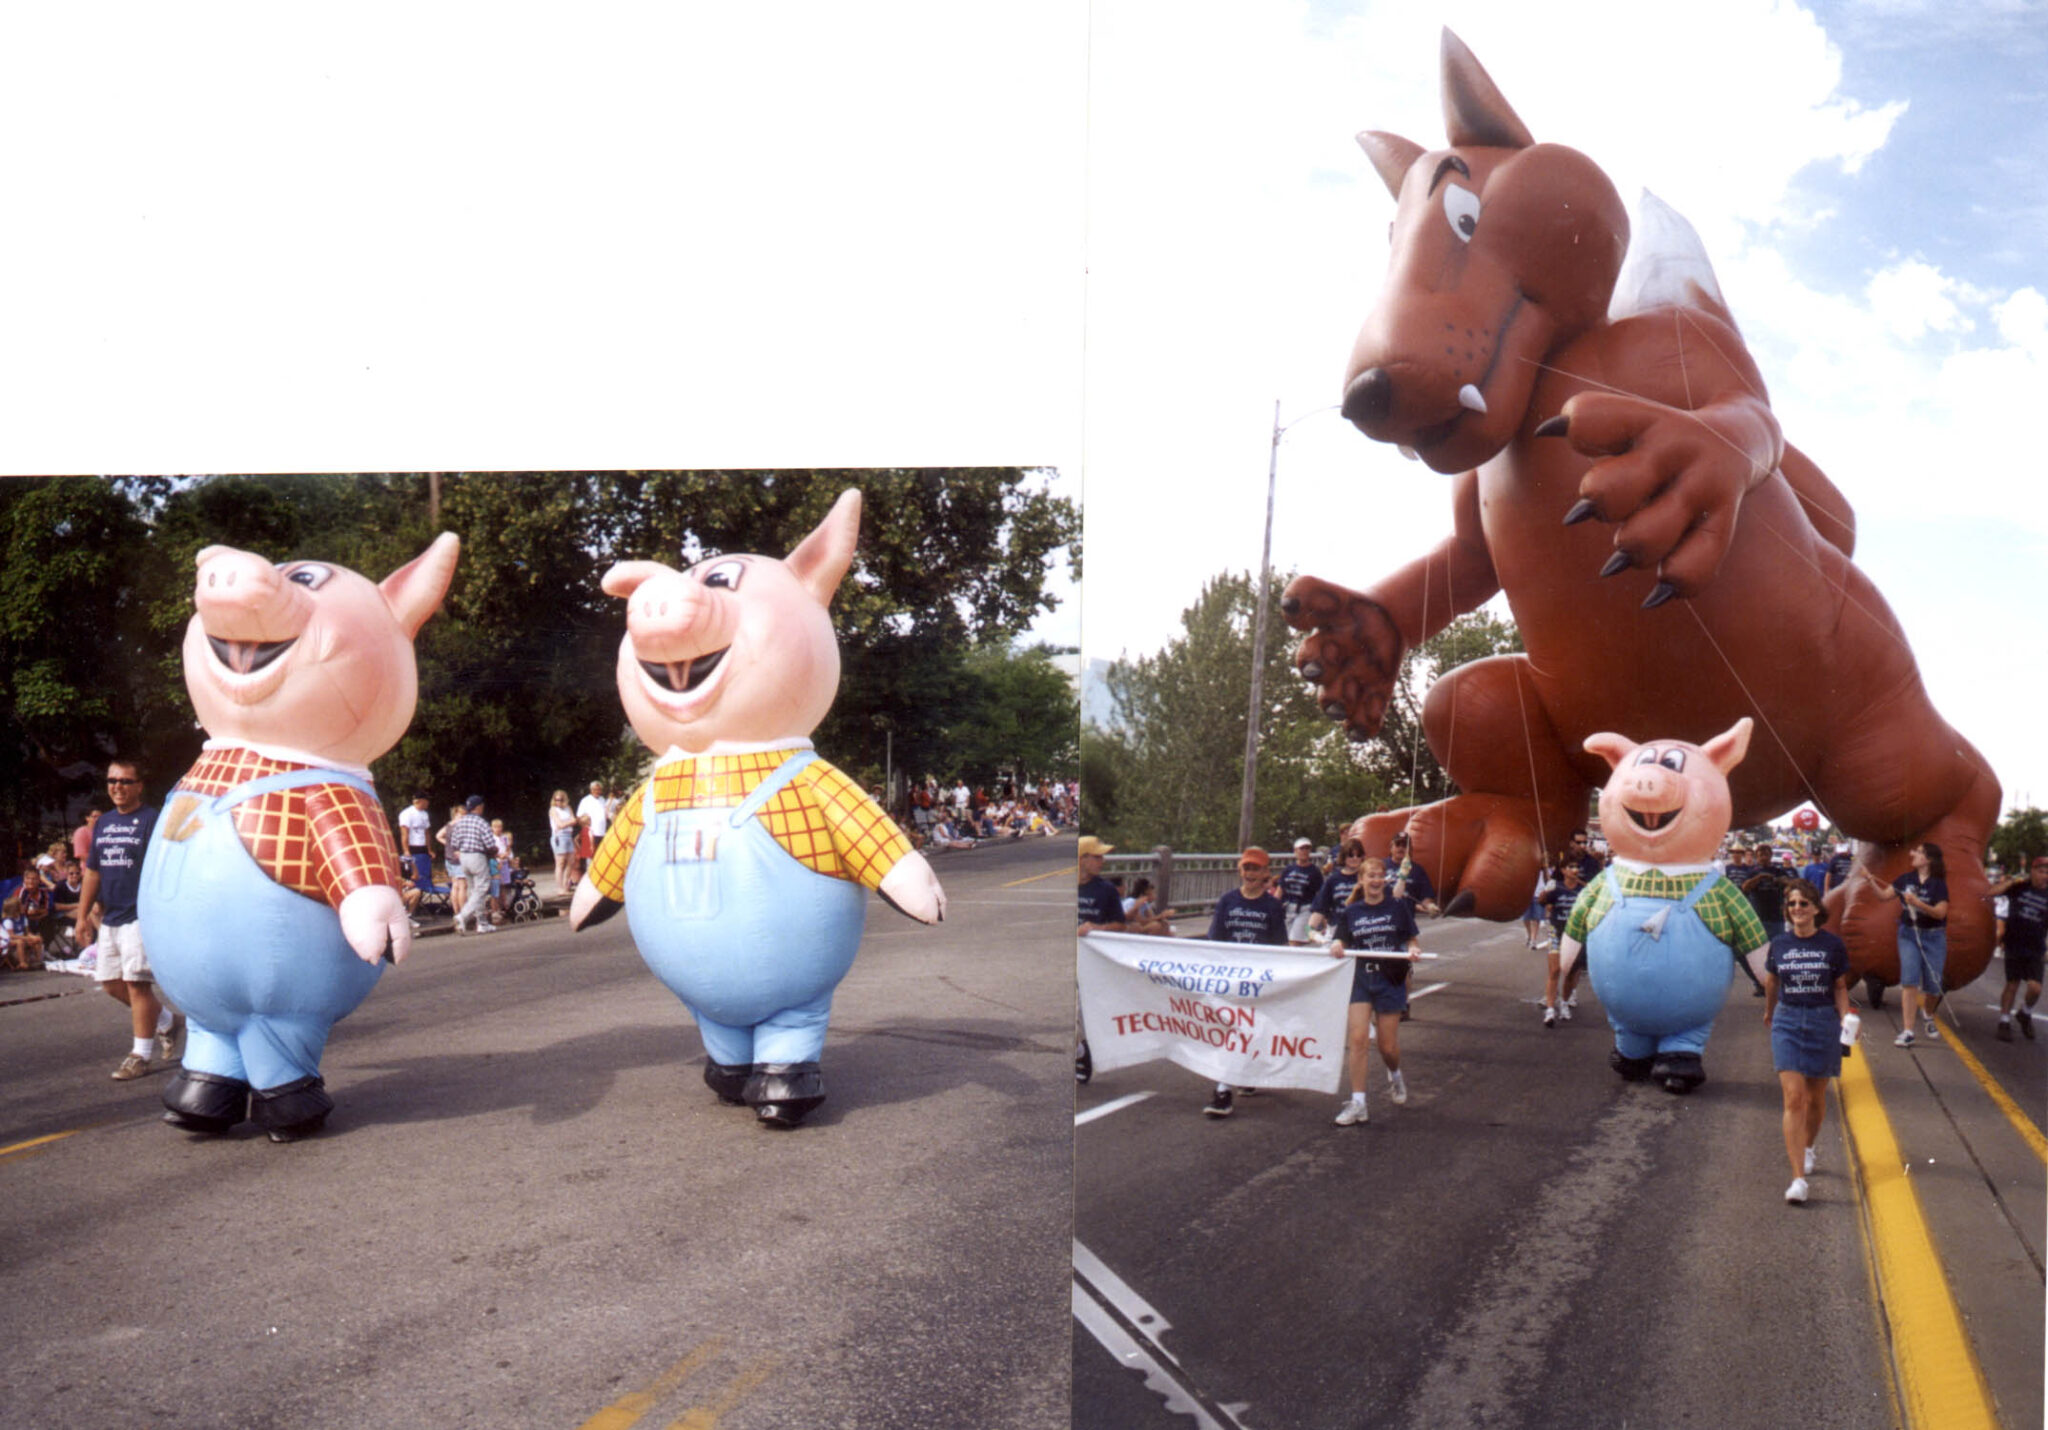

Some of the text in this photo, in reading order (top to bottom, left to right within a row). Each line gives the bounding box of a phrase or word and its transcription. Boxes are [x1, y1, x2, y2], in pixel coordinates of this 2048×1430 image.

[1782, 948, 1828, 961] efficiency
[1137, 959, 1274, 982] SPONSORED &
[1790, 971, 1821, 985] agility
[1150, 974, 1264, 998] HANDLED BY
[1169, 996, 1256, 1028] MICRON
[1112, 1012, 1322, 1060] TECHNOLOGY, INC.
